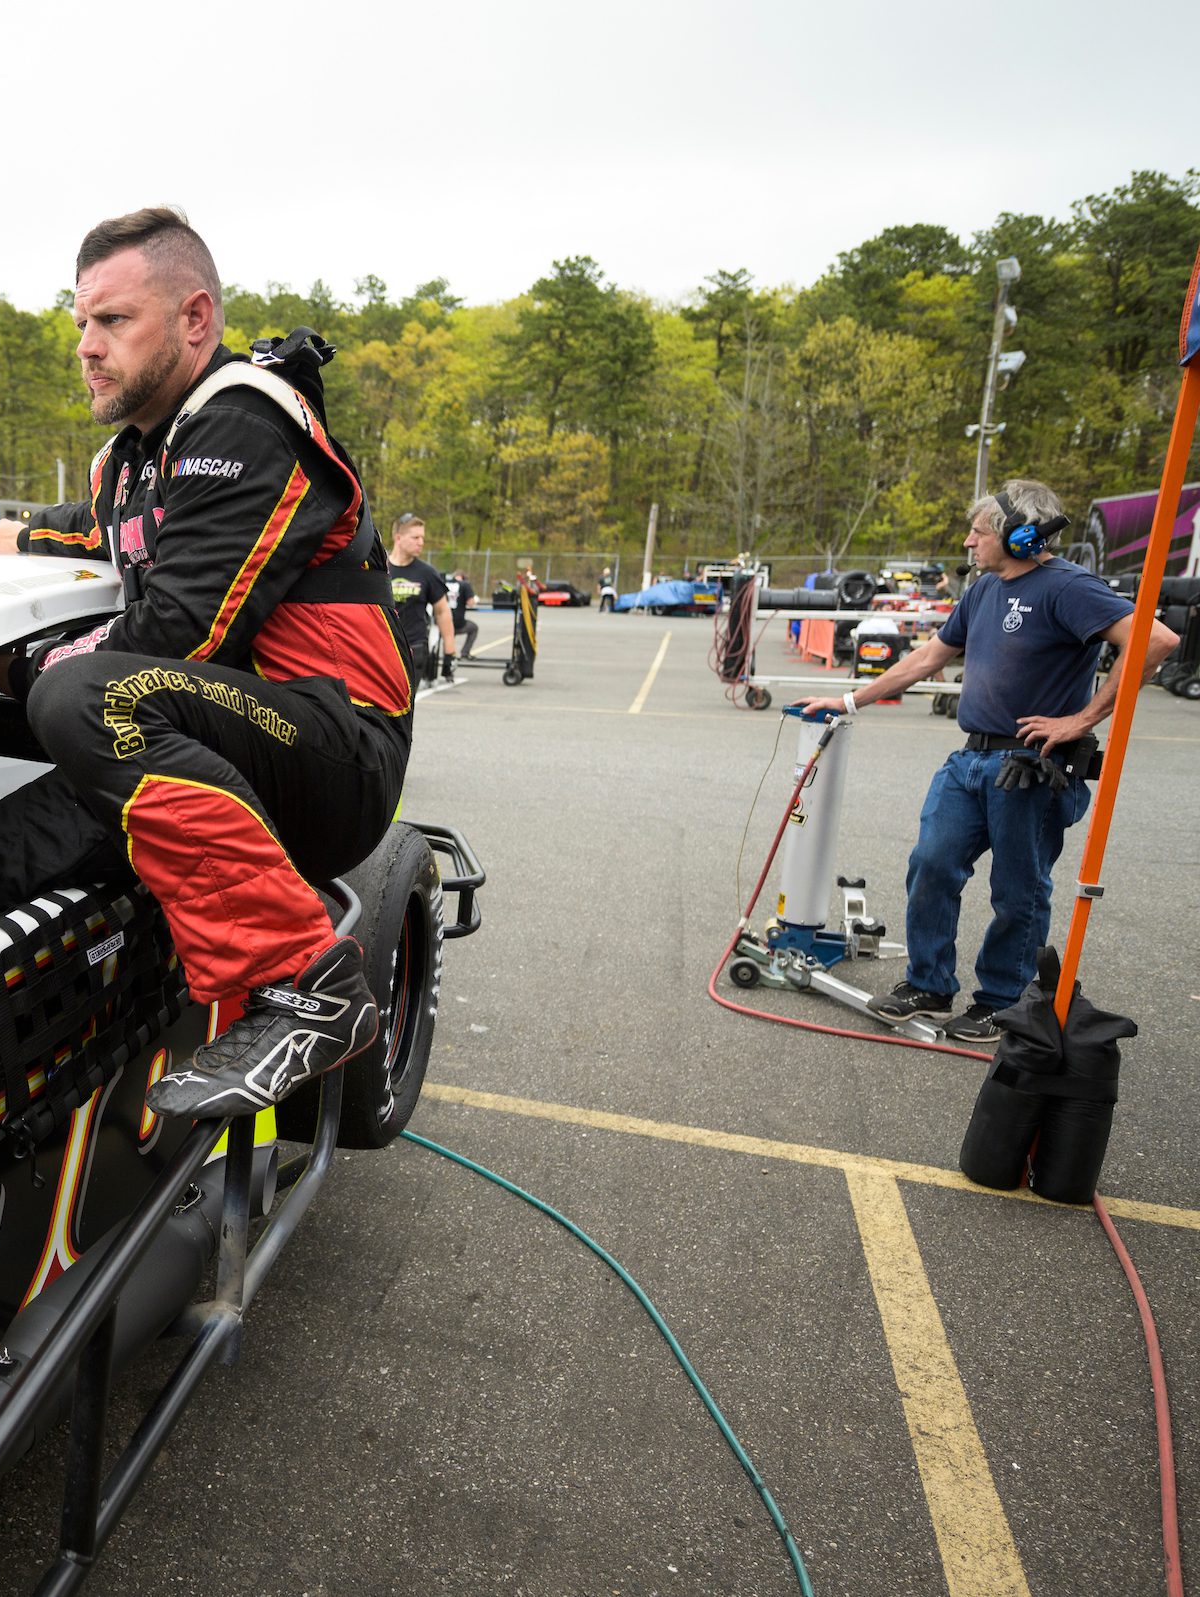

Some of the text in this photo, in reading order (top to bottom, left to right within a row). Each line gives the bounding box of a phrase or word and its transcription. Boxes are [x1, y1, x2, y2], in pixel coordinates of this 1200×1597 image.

[181, 457, 244, 480] NASCAR
[196, 675, 245, 717] Build
[245, 693, 298, 747] Better
